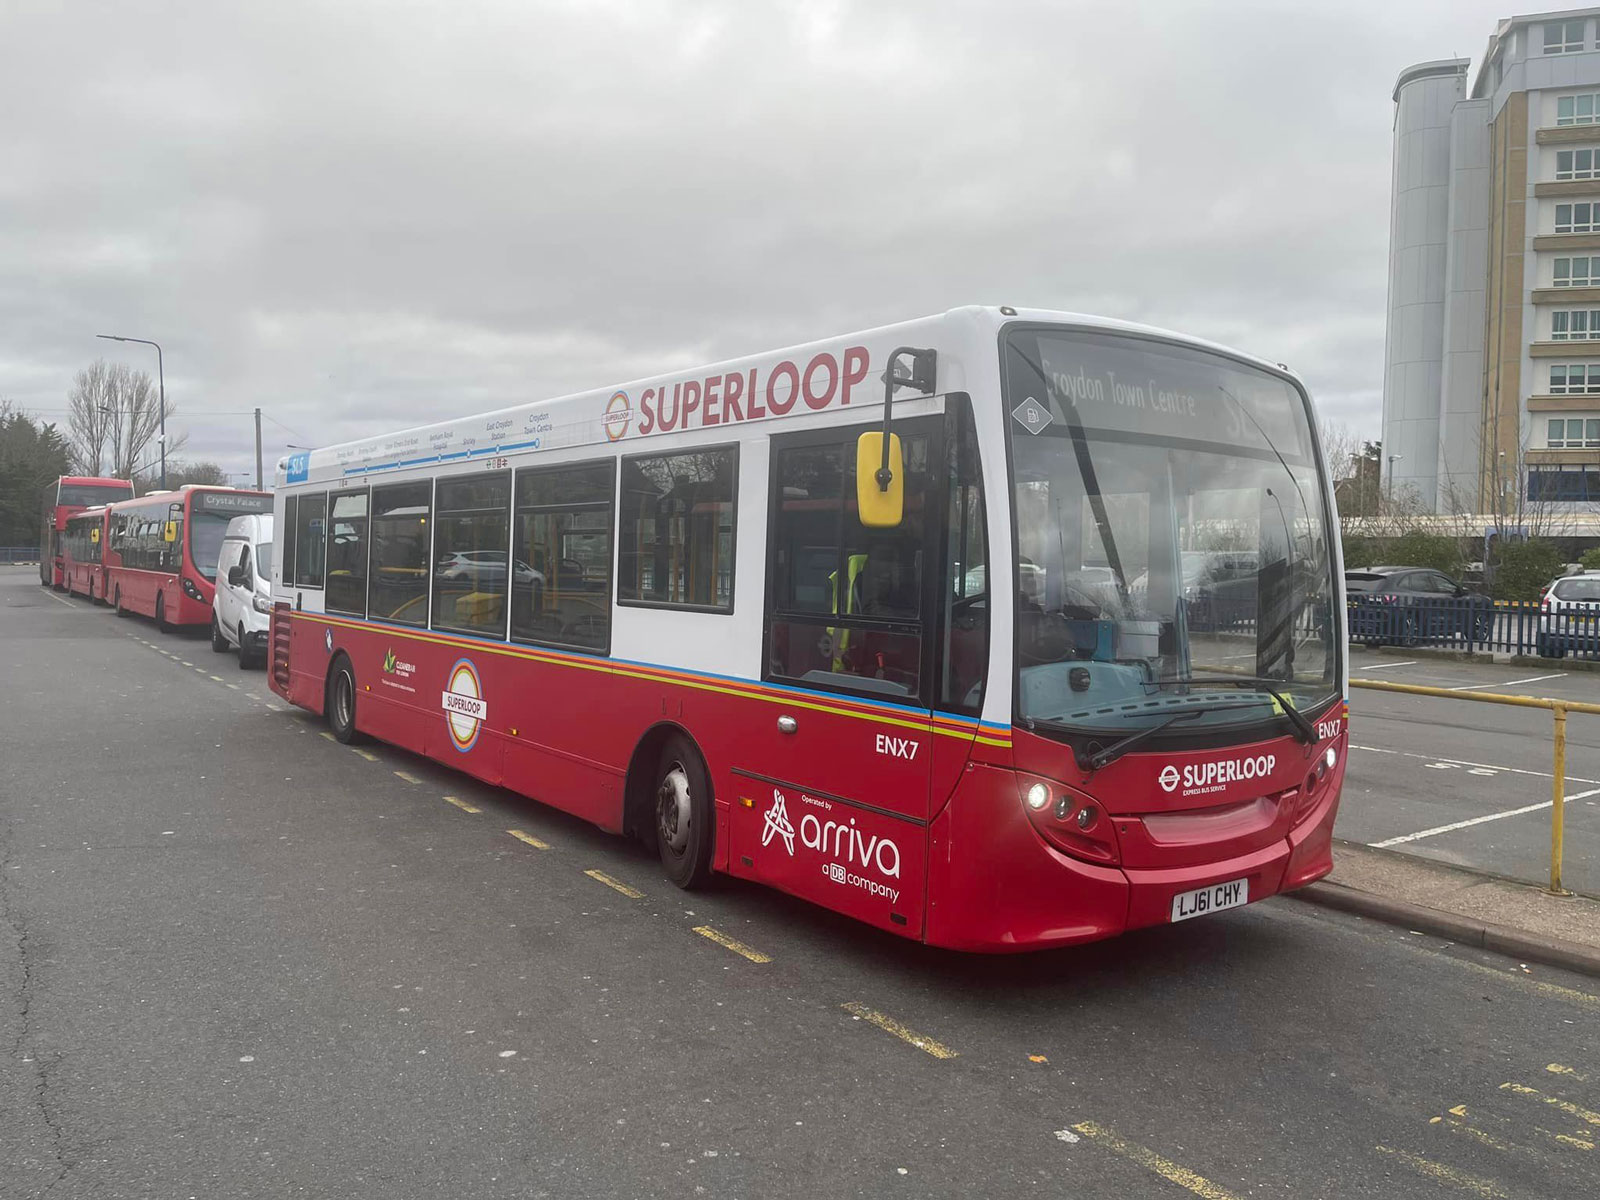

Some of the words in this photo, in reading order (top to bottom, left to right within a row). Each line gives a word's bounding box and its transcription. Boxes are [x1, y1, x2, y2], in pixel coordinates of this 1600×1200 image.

[638, 346, 870, 435] SUPERLOOP
[1107, 371, 1145, 409] Town
[1149, 380, 1196, 417] Centre
[486, 422, 495, 431] East
[495, 420, 513, 429] Croydon
[529, 413, 550, 423] Croydon
[605, 411, 630, 423] SUPERLOOP
[491, 432, 506, 440] Station
[524, 426, 536, 435] Town
[536, 424, 553, 432] Centre
[206, 495, 235, 506] Crystal
[447, 695, 481, 715] SUPERLOOP
[1318, 719, 1341, 740] ENX7
[876, 734, 919, 760] ENX7
[1183, 754, 1276, 788] SUPERLOOP
[1183, 788, 1201, 796] EXPRESS
[1210, 784, 1226, 793] SERVICE
[801, 794, 824, 808] Operated
[825, 801, 832, 811] by
[800, 814, 900, 879] arriva
[822, 864, 829, 875] a
[831, 865, 845, 882] DB
[847, 872, 900, 904] company
[1179, 894, 1211, 917] LJ61
[1214, 882, 1241, 906] CHY
